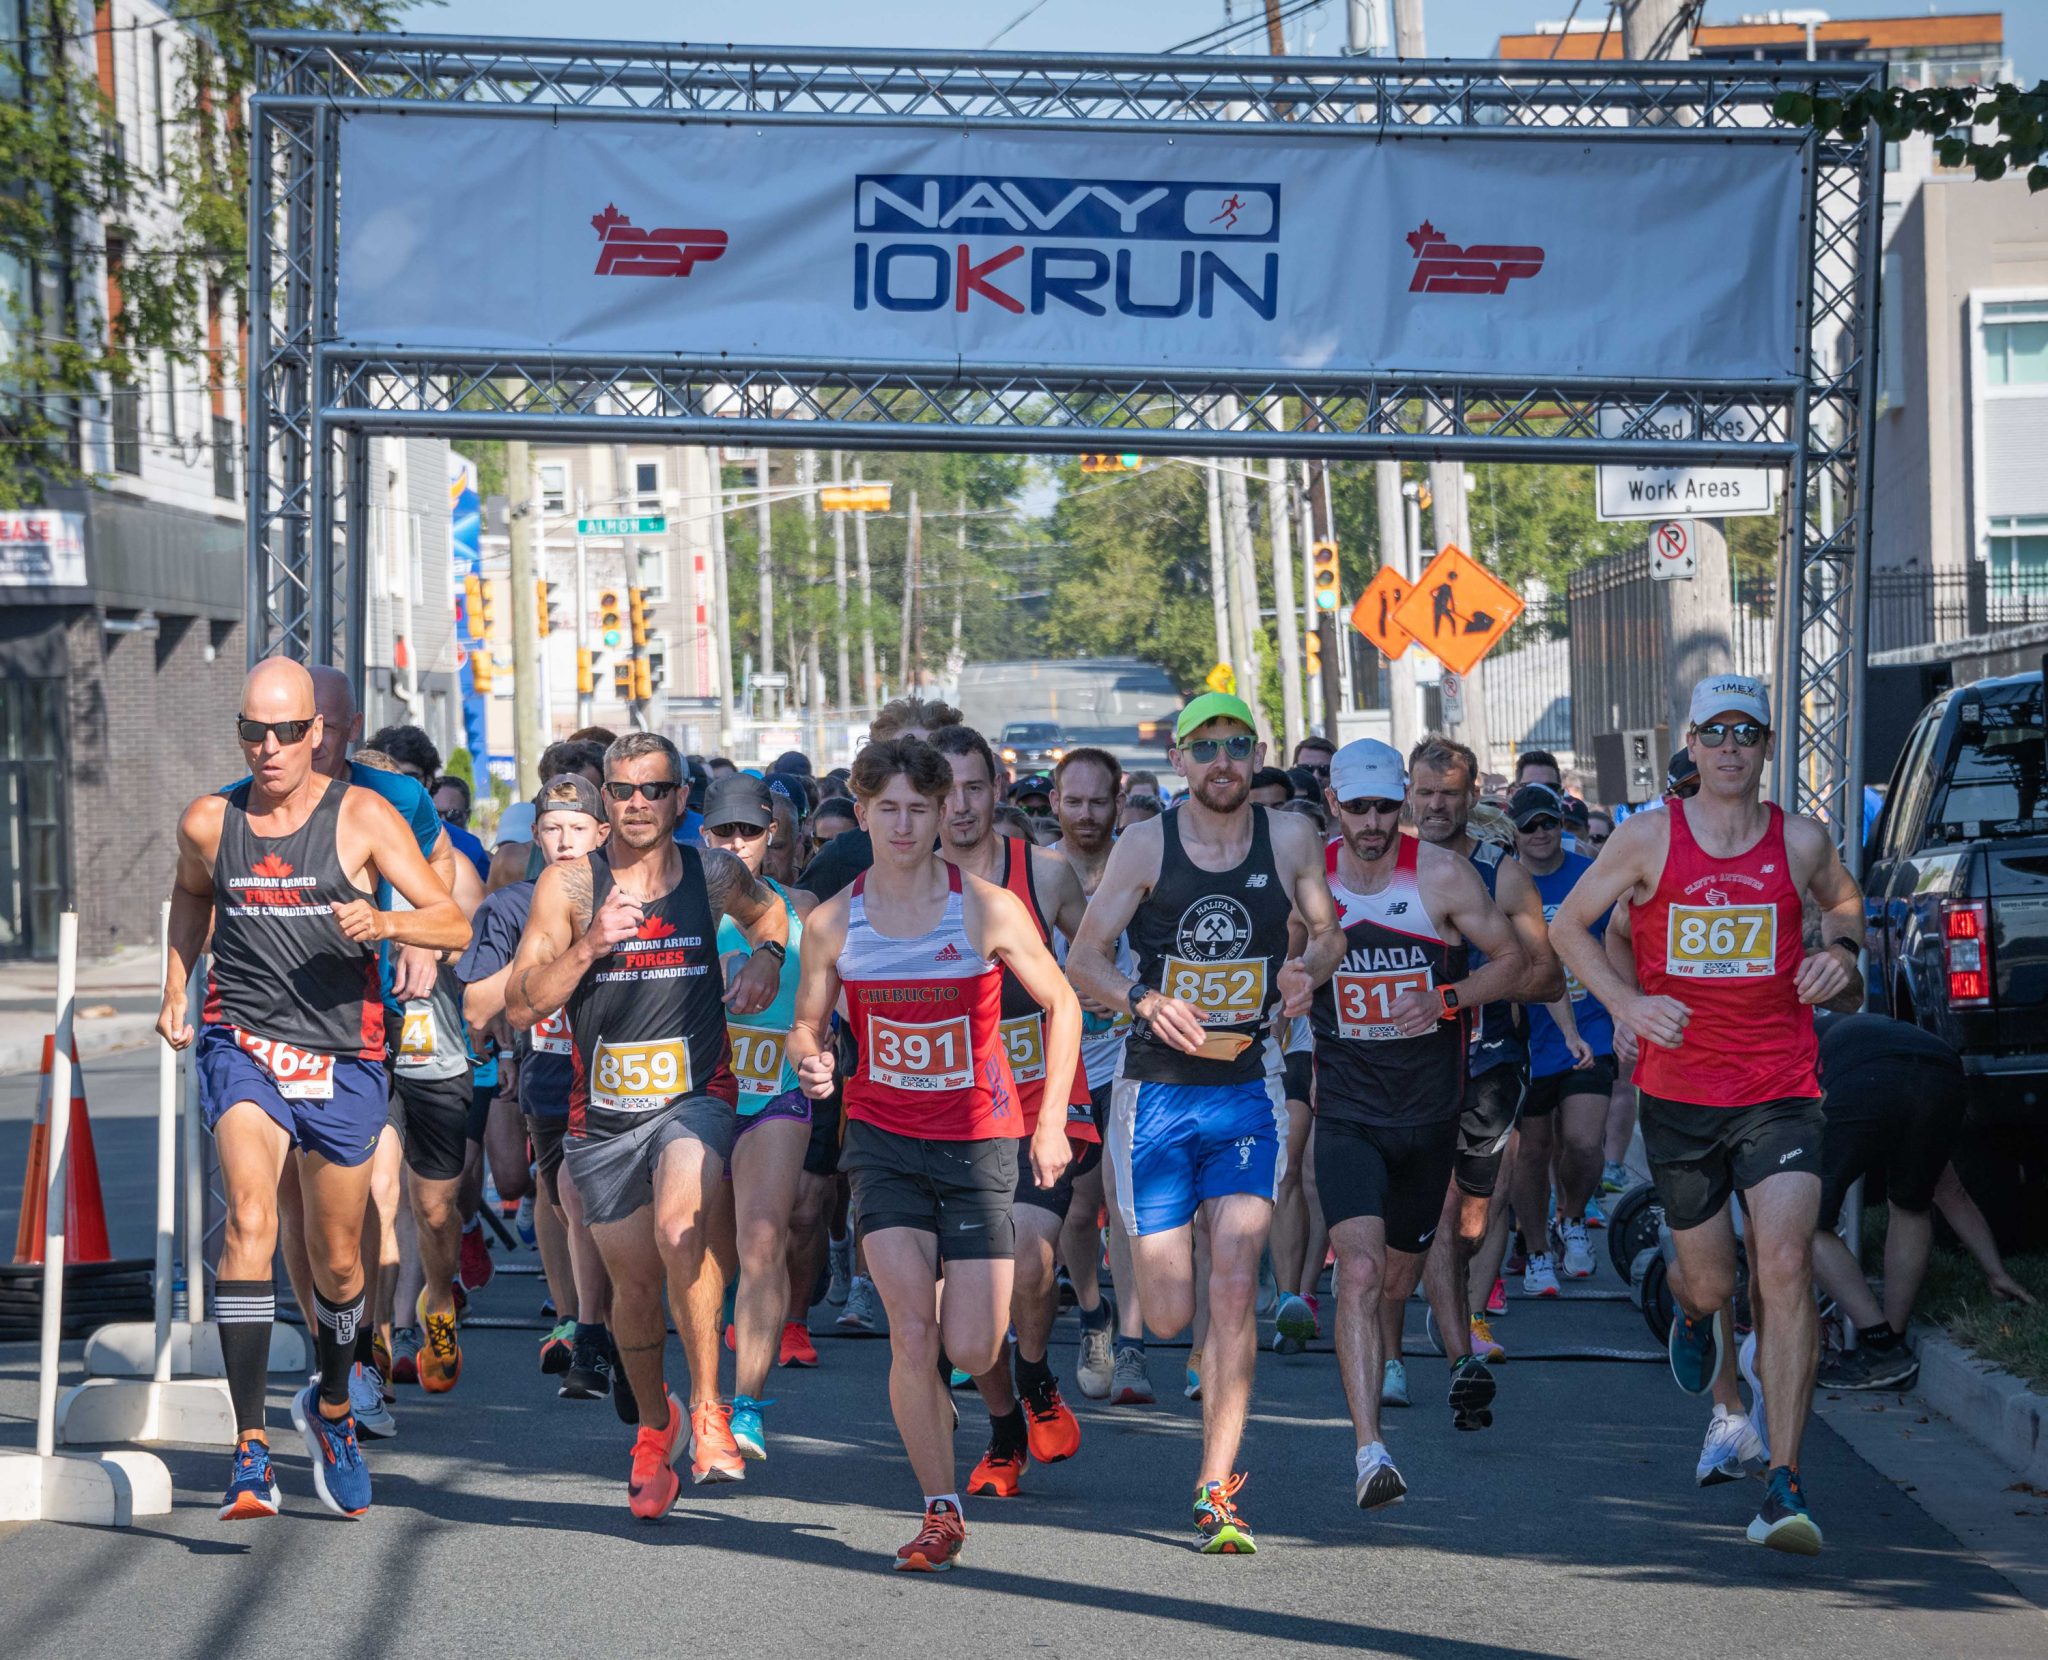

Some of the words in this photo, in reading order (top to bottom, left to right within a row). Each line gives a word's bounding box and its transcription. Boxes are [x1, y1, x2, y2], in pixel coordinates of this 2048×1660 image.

[860, 181, 1169, 233] NAVY
[1629, 480, 1677, 501] Work
[1685, 478, 1740, 498] Areas
[0, 521, 49, 541] EASE
[587, 520, 639, 534] ALMON
[1712, 683, 1754, 693] TIMEX
[229, 878, 279, 888] CANADIAN
[281, 877, 317, 887] ARMED
[245, 890, 302, 904] FORCES
[1195, 901, 1237, 916] HALIFAX
[1680, 916, 1763, 955] 867
[611, 940, 661, 952] ANADIAN
[664, 936, 701, 947] ARMED
[625, 951, 685, 968] FORCES
[935, 953, 962, 961] adidas
[1338, 946, 1427, 971] ANADA
[595, 970, 638, 982] ARMÉES
[858, 987, 959, 1003] CHEBUCTO
[1173, 970, 1255, 1006] 852
[878, 1030, 954, 1070] 391
[600, 1051, 678, 1091] 859
